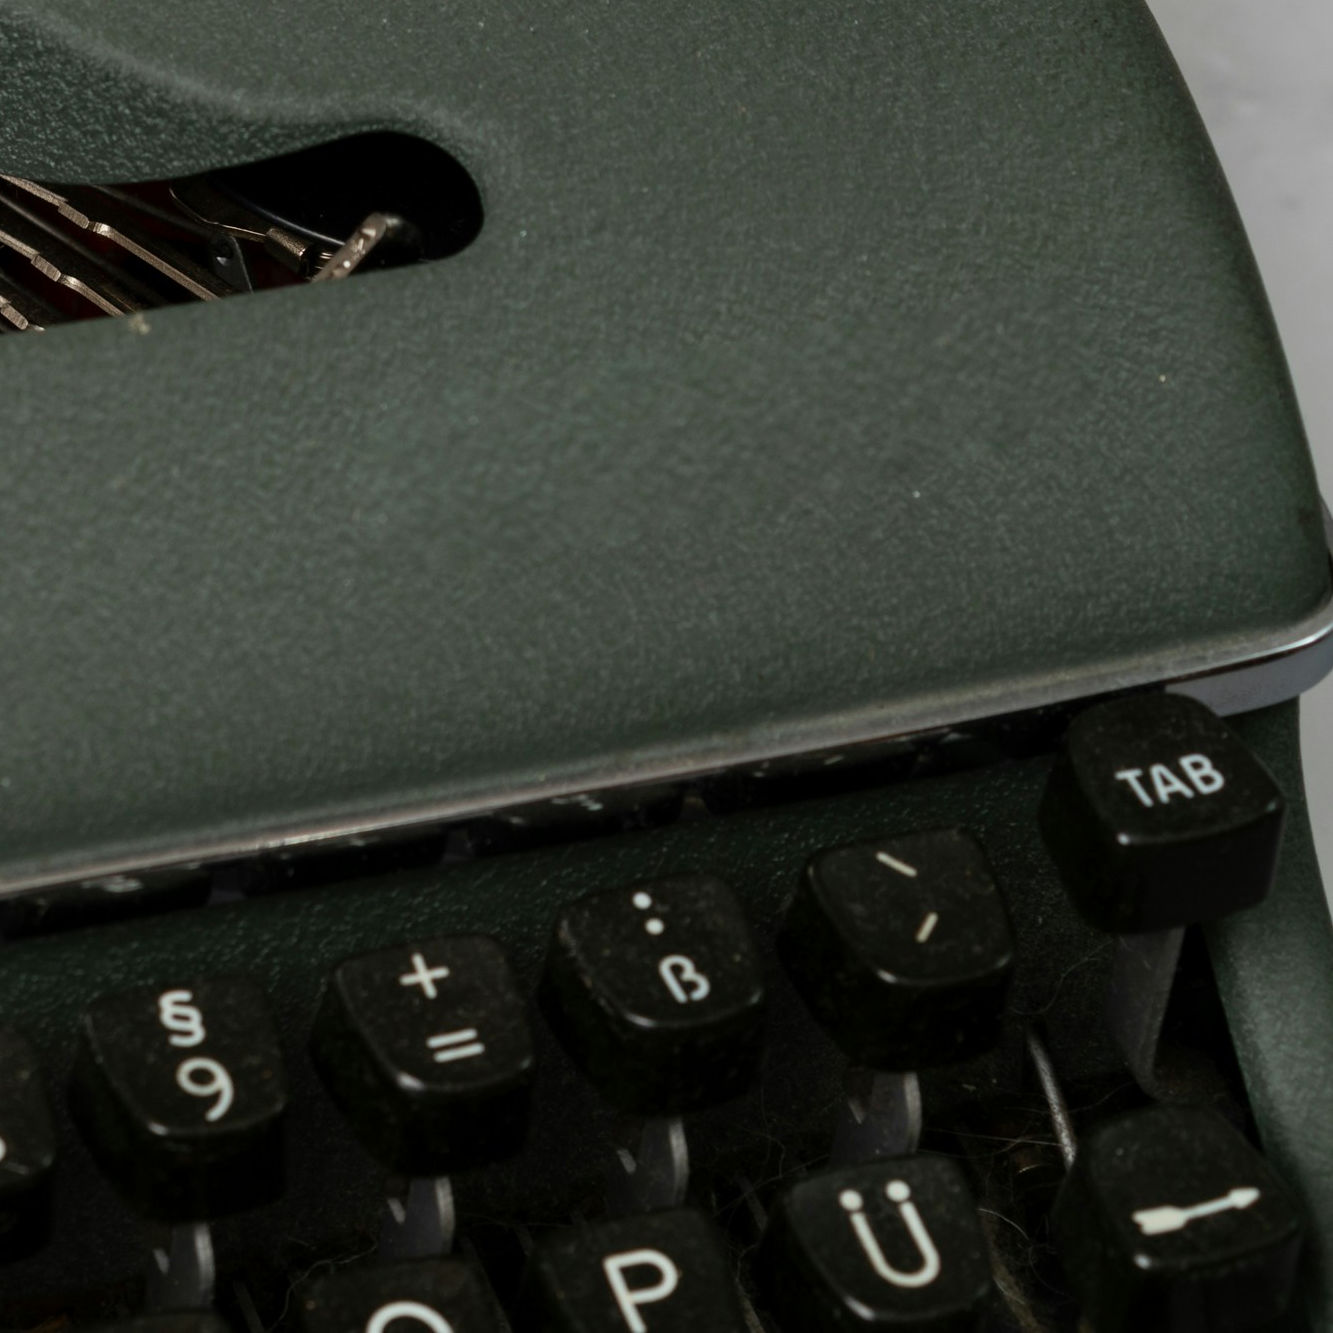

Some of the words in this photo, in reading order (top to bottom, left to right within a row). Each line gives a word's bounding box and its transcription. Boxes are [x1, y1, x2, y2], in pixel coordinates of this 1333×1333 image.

[1115, 754, 1224, 806] TAB
[401, 954, 449, 998] +
[659, 955, 710, 1003] ß
[159, 990, 205, 1047] §
[427, 1028, 484, 1062] =
[177, 1058, 234, 1121] 9
[839, 1180, 940, 1287] Ü
[604, 1249, 678, 1333] P
